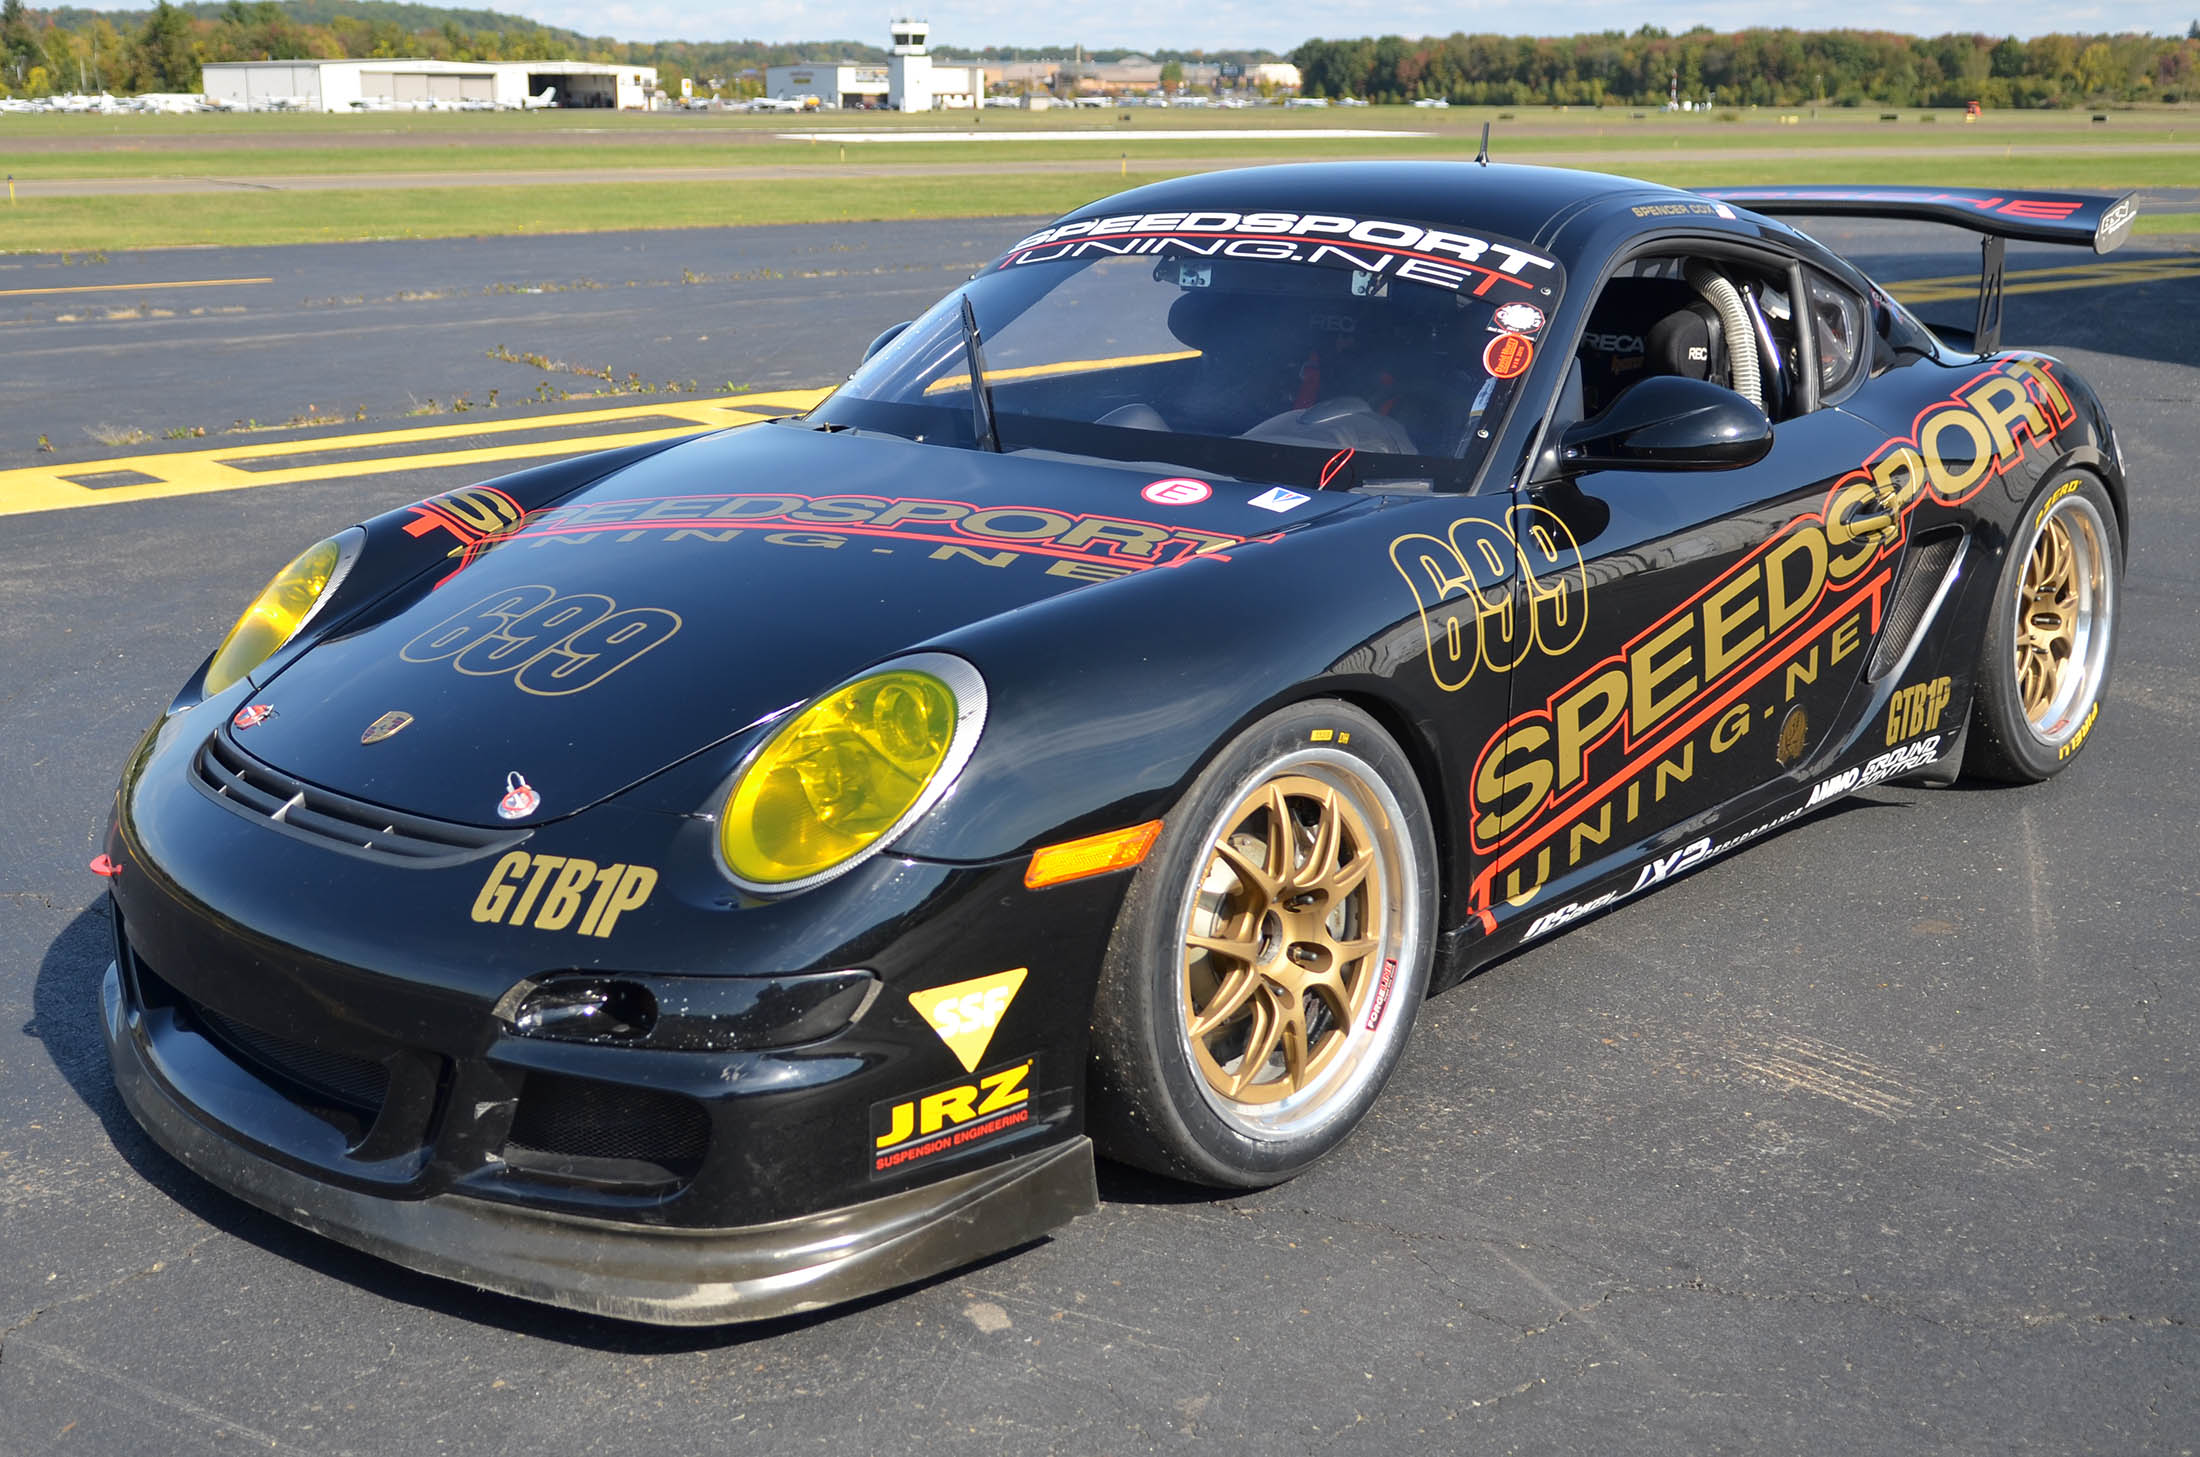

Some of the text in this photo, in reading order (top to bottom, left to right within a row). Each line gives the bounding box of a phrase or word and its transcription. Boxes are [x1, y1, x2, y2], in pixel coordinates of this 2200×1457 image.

[1008, 212, 1555, 275] SPEEDSPORT
[1632, 205, 1689, 217] SPENCER
[1389, 504, 1588, 692] 699
[1477, 357, 2068, 840] SPEEDSPORT
[400, 584, 683, 696] 699
[1886, 676, 1952, 747] GTB1P
[1851, 750, 1938, 791] CONTROL
[1861, 735, 1940, 778] GROUND
[471, 851, 658, 938] GTB1P
[933, 986, 1009, 1039] SSF
[876, 1063, 1029, 1149] JRZ
[876, 1109, 1028, 1171] SUSPENSION ENGINEERING
